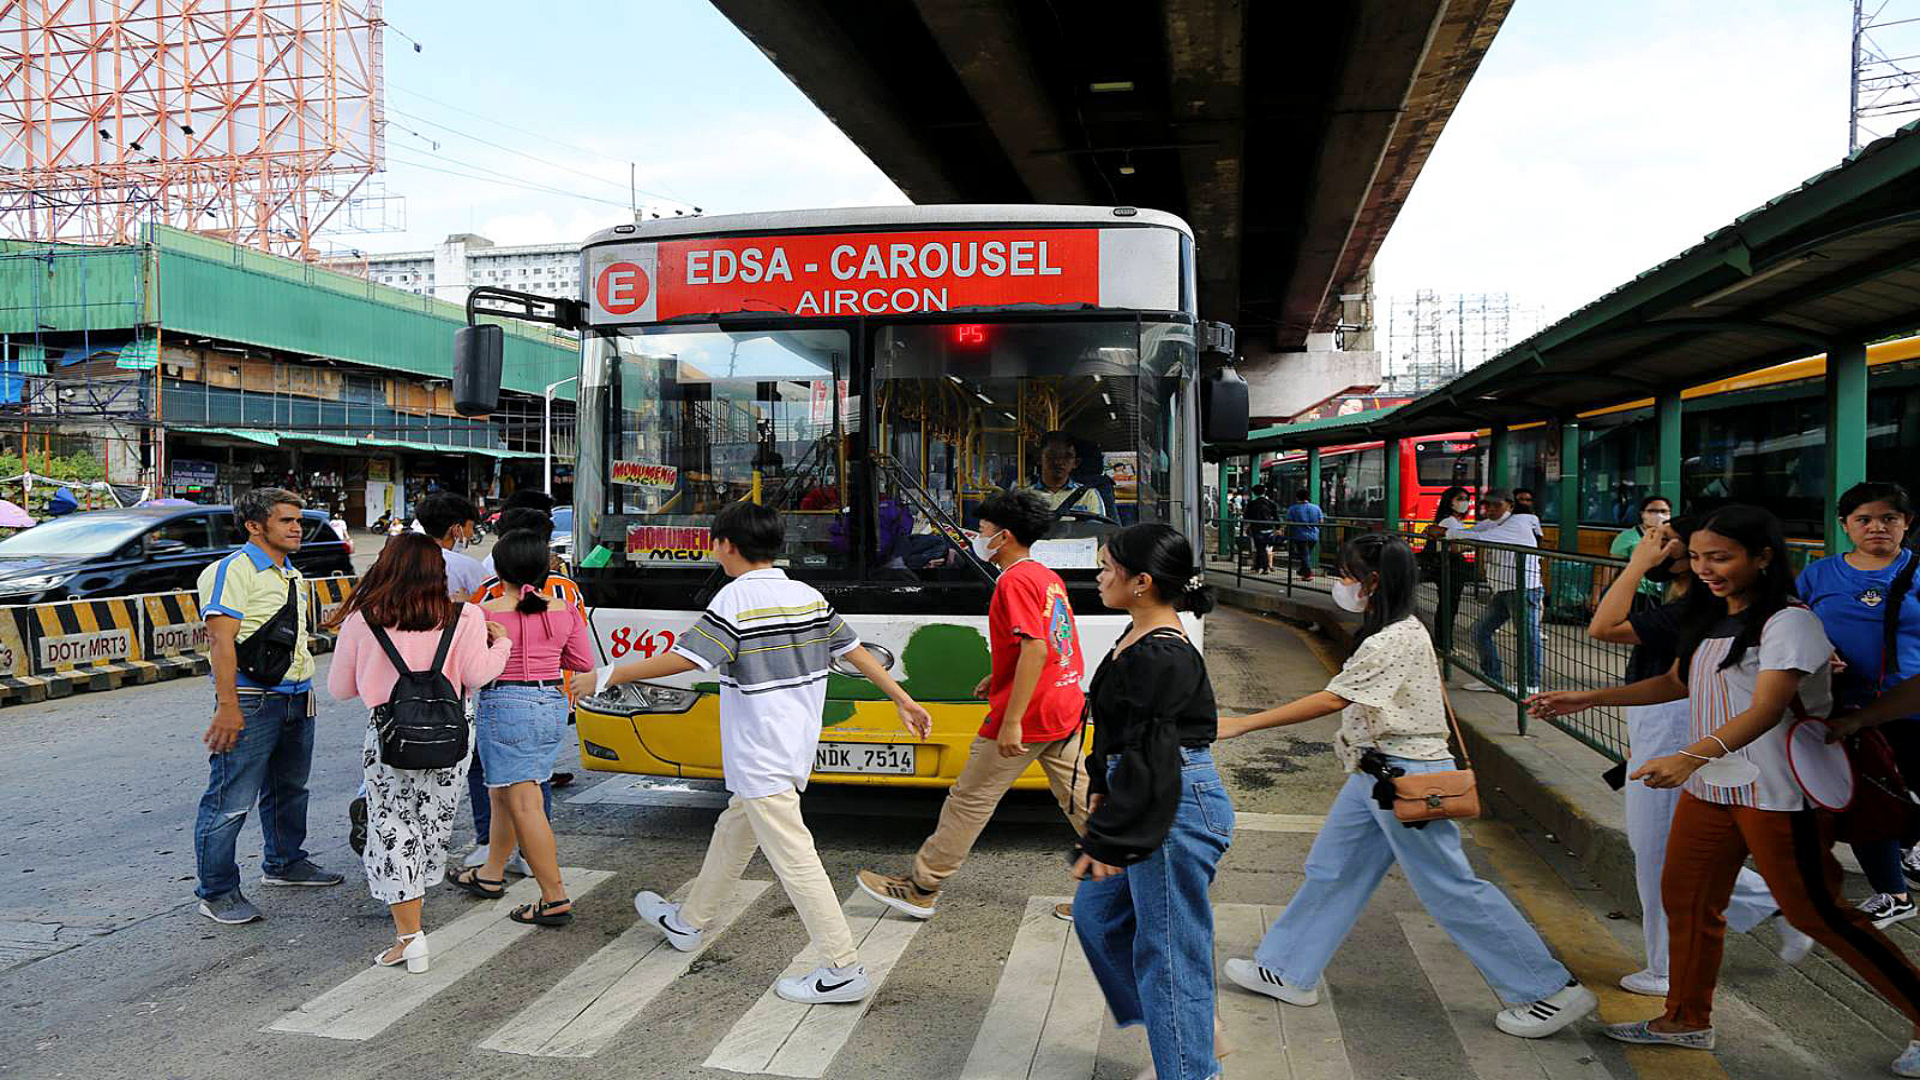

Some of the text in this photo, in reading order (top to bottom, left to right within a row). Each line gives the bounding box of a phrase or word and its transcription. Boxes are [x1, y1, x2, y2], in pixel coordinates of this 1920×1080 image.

[686, 248, 793, 285] EDSA
[830, 240, 1062, 281] CAROUSEL
[608, 271, 636, 306] E
[794, 287, 948, 315] AIRCON
[627, 526, 715, 553] MONUMEN
[649, 549, 703, 560] MCU
[48, 636, 127, 662] DOTr MRT3
[156, 630, 187, 649] DOTr
[611, 626, 687, 659] 842
[816, 749, 911, 768] NDK 7514
